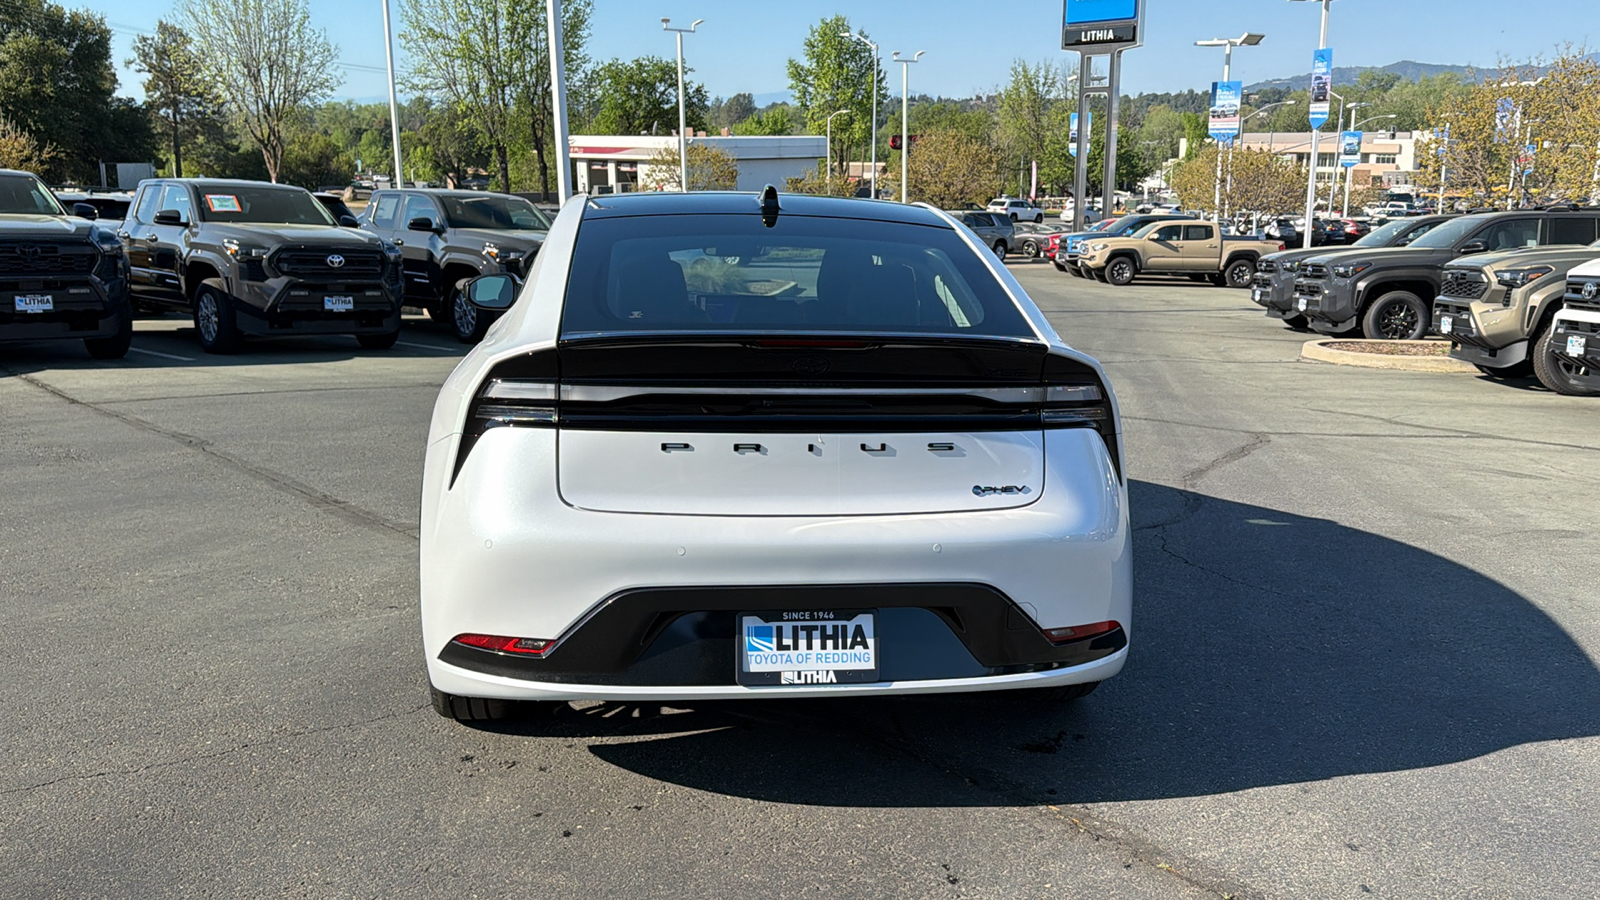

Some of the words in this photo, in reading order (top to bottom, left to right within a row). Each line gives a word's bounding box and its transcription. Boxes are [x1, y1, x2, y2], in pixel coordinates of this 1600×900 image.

[1081, 29, 1114, 42] LITHIA
[660, 442, 955, 453] PRIUS
[983, 484, 1027, 494] PHEV
[782, 611, 811, 620] SINCE
[813, 611, 835, 619] 1946
[775, 624, 869, 651] LITHIA
[748, 653, 793, 666] TOYOTA
[796, 652, 814, 664] OF
[816, 652, 871, 664] REDDING
[793, 670, 837, 683] LITHIA
